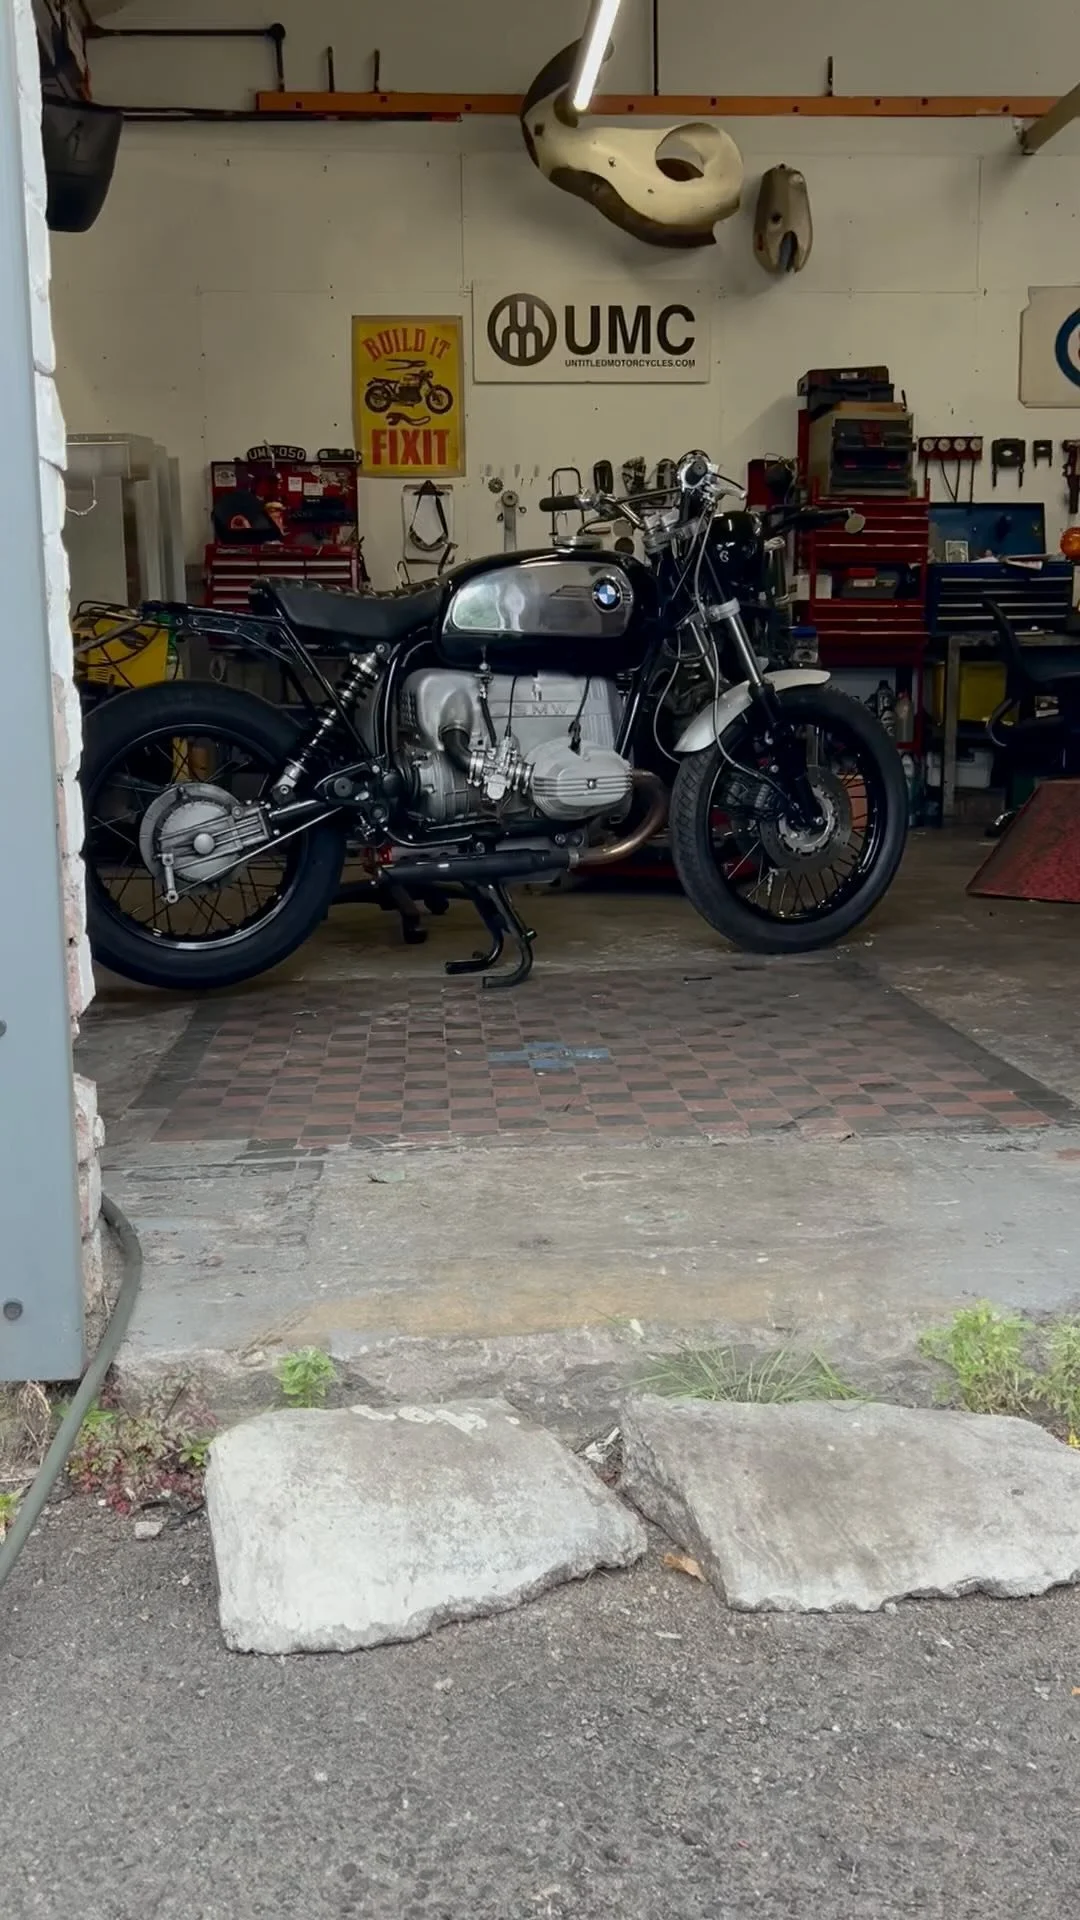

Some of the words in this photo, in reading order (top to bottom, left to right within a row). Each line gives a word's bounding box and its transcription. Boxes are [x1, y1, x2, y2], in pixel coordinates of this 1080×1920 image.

[362, 327, 427, 363] BUILD
[429, 336, 452, 360] IT
[565, 304, 696, 356] UMC
[564, 359, 696, 368] UNTITLEDMOTORCYCLES.COM
[371, 429, 451, 466] FIXIT
